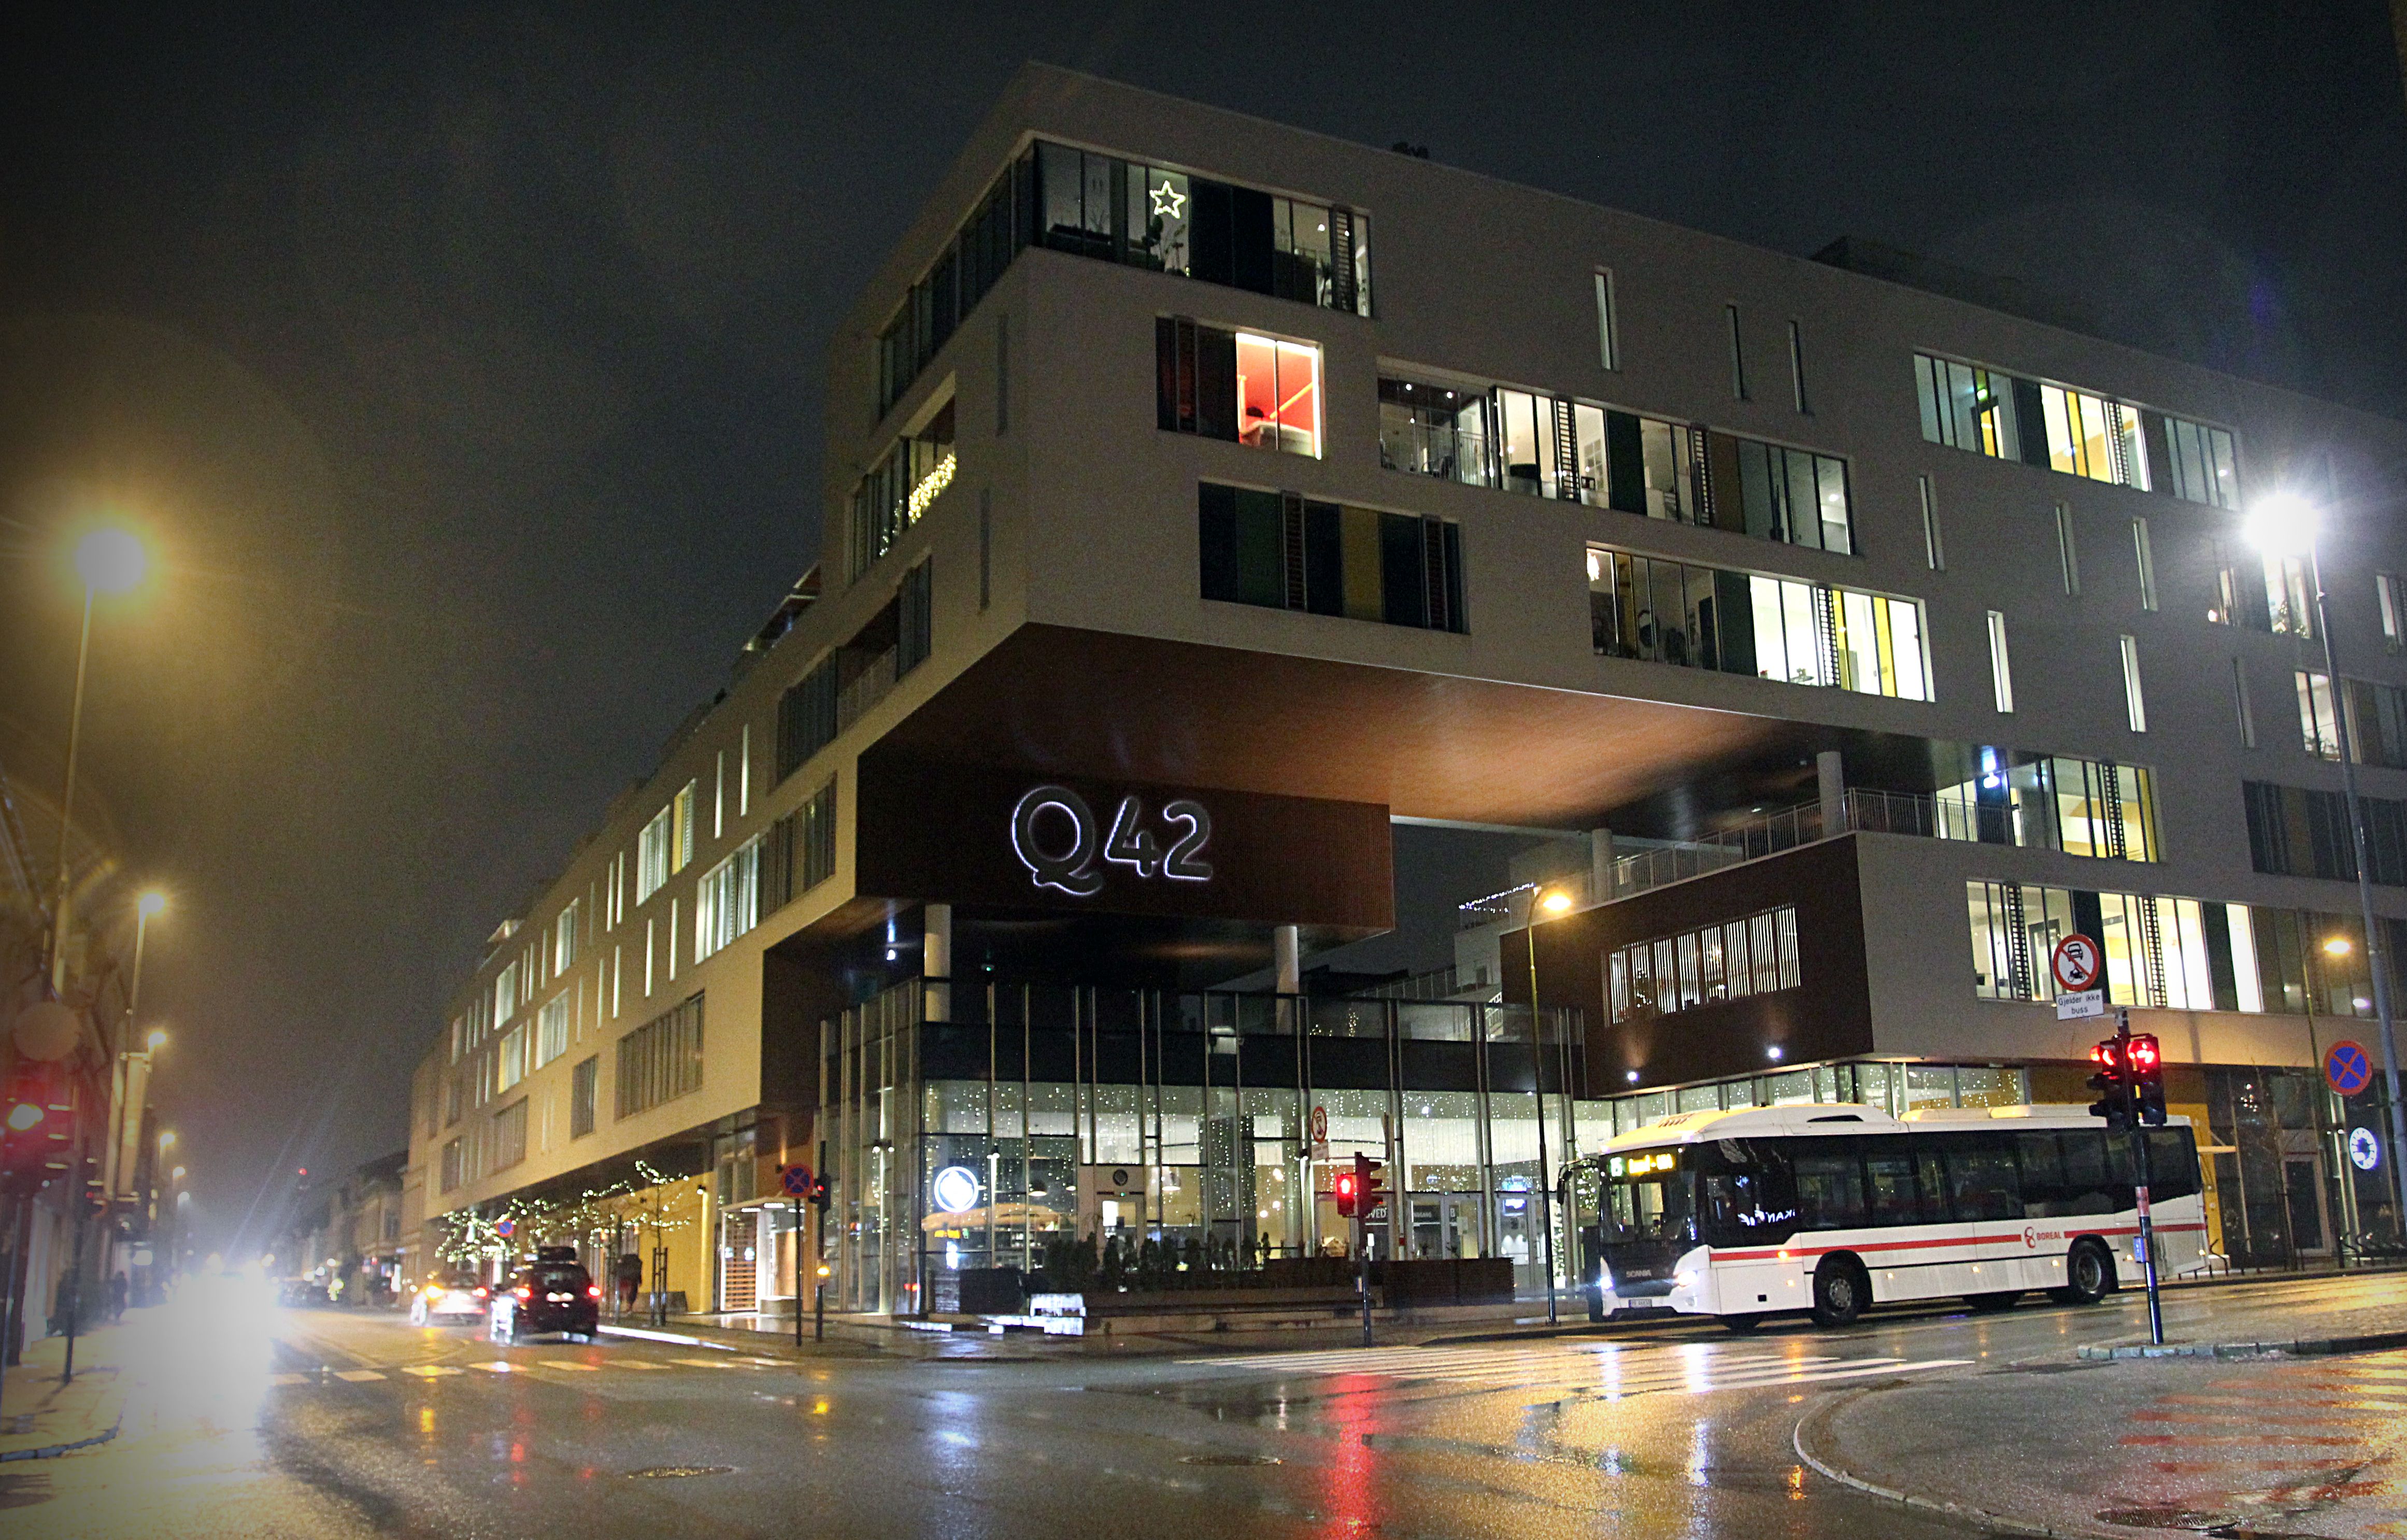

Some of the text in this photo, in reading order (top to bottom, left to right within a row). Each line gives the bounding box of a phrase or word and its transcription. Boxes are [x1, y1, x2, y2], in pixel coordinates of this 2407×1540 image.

[1011, 785, 1213, 895] Q42
[2058, 993, 2100, 1007] Gjelder ikke
[2037, 1232, 2061, 1240] BOREAL
